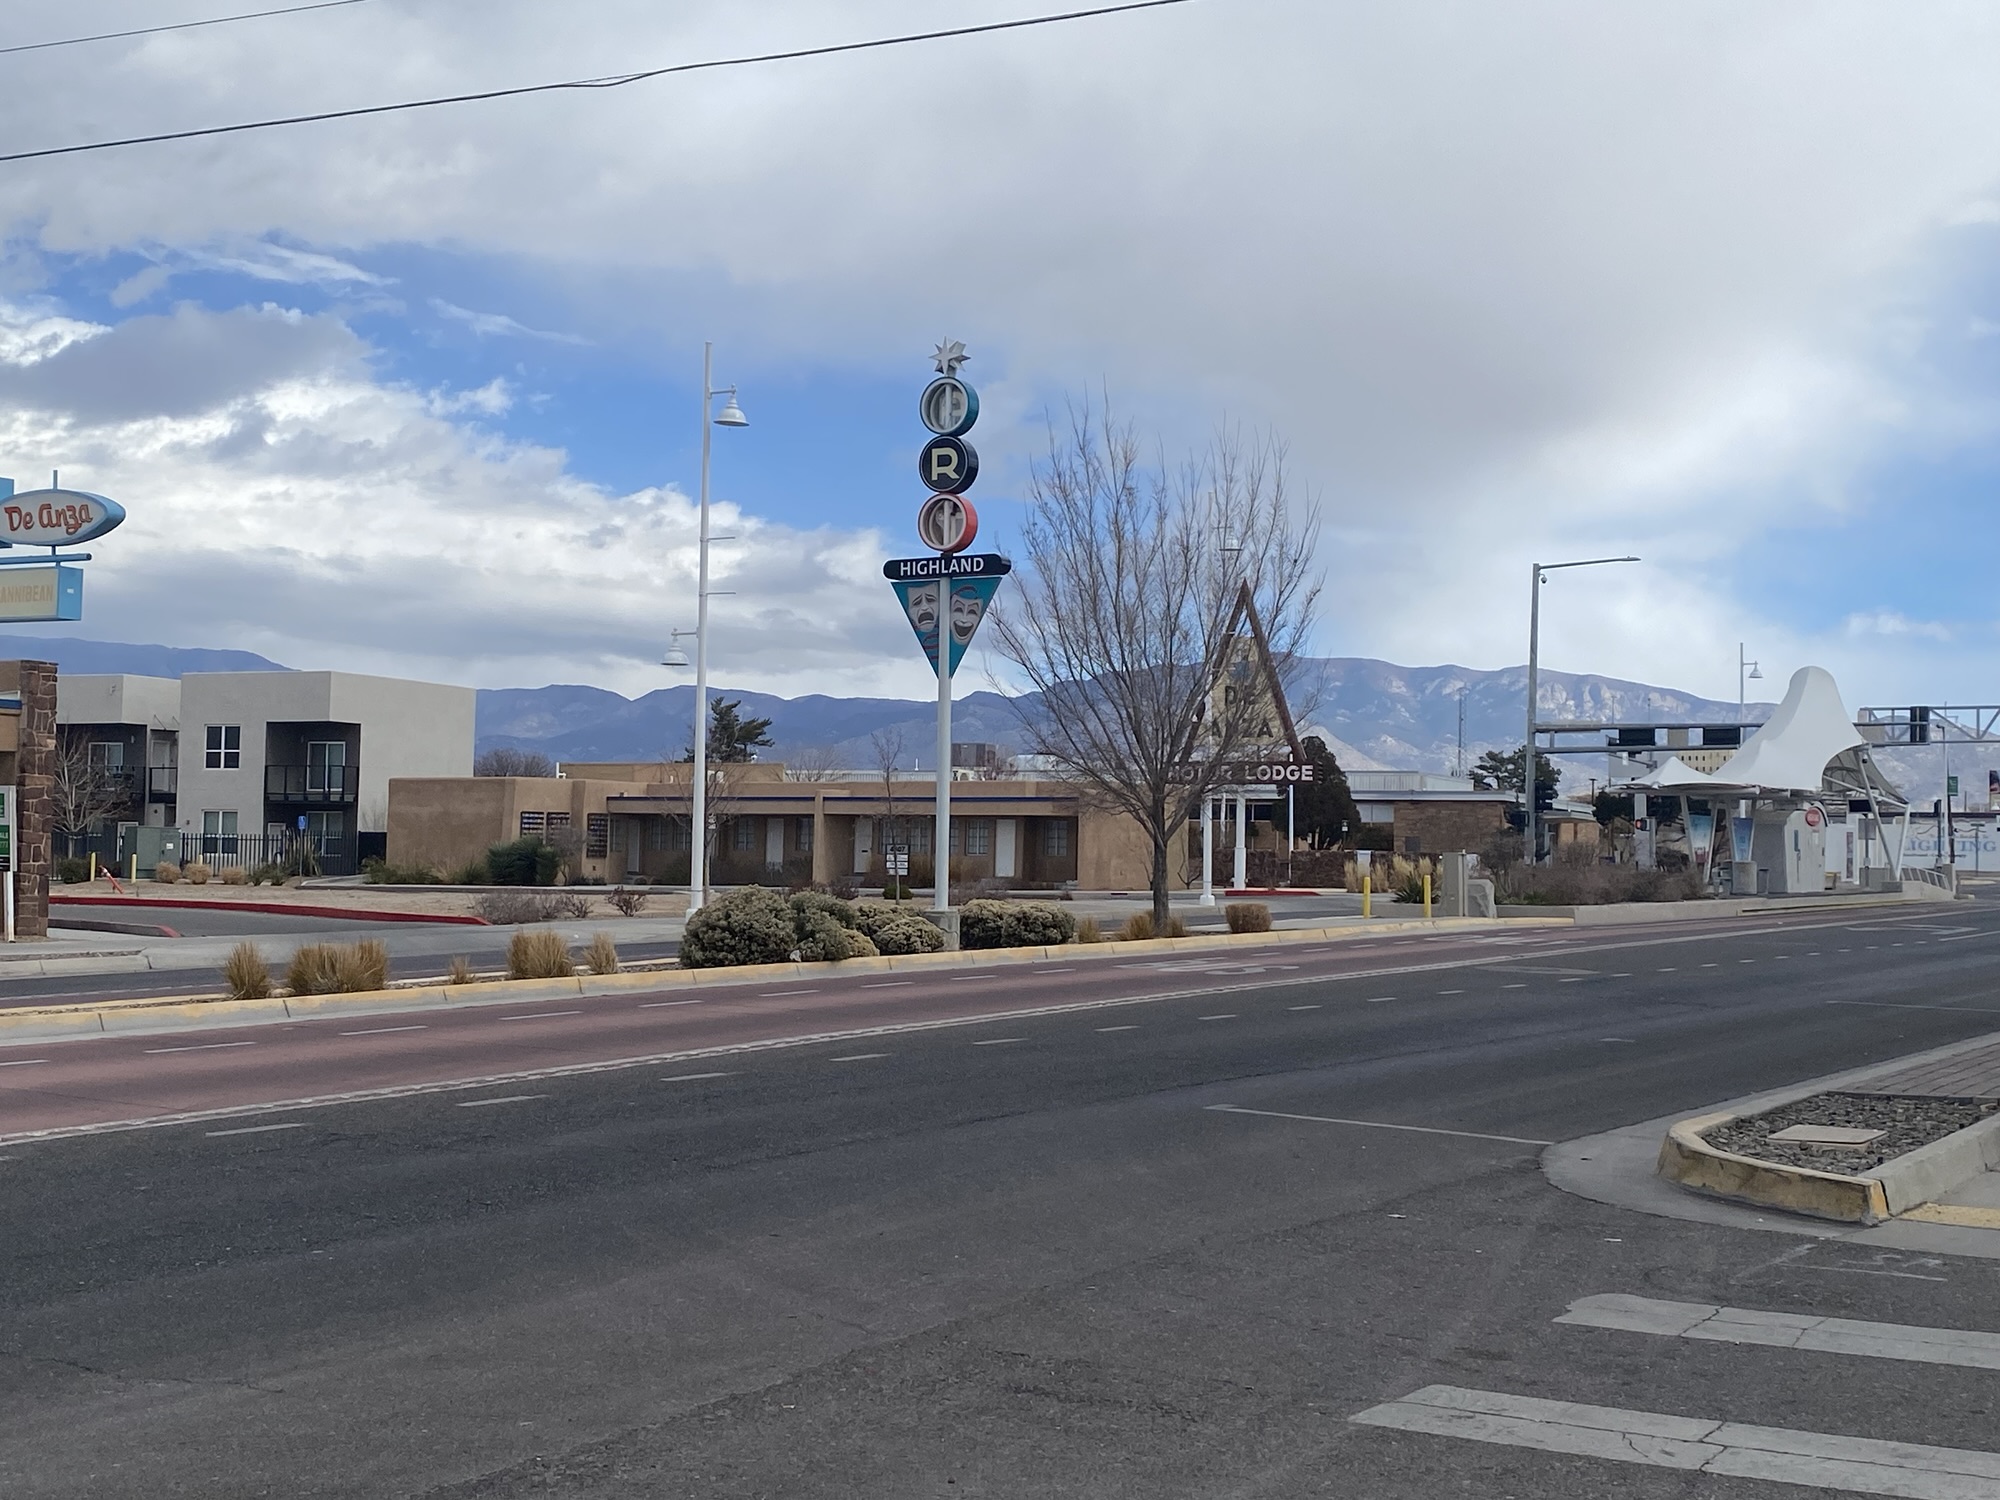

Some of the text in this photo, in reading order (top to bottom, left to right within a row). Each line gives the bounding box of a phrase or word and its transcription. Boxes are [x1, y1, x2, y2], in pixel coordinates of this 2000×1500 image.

[931, 447, 960, 481] R
[4, 503, 93, 535] De Anza
[900, 557, 984, 576] HIGHLAND
[1244, 765, 1314, 781] LODGE
[890, 845, 906, 853] 407
